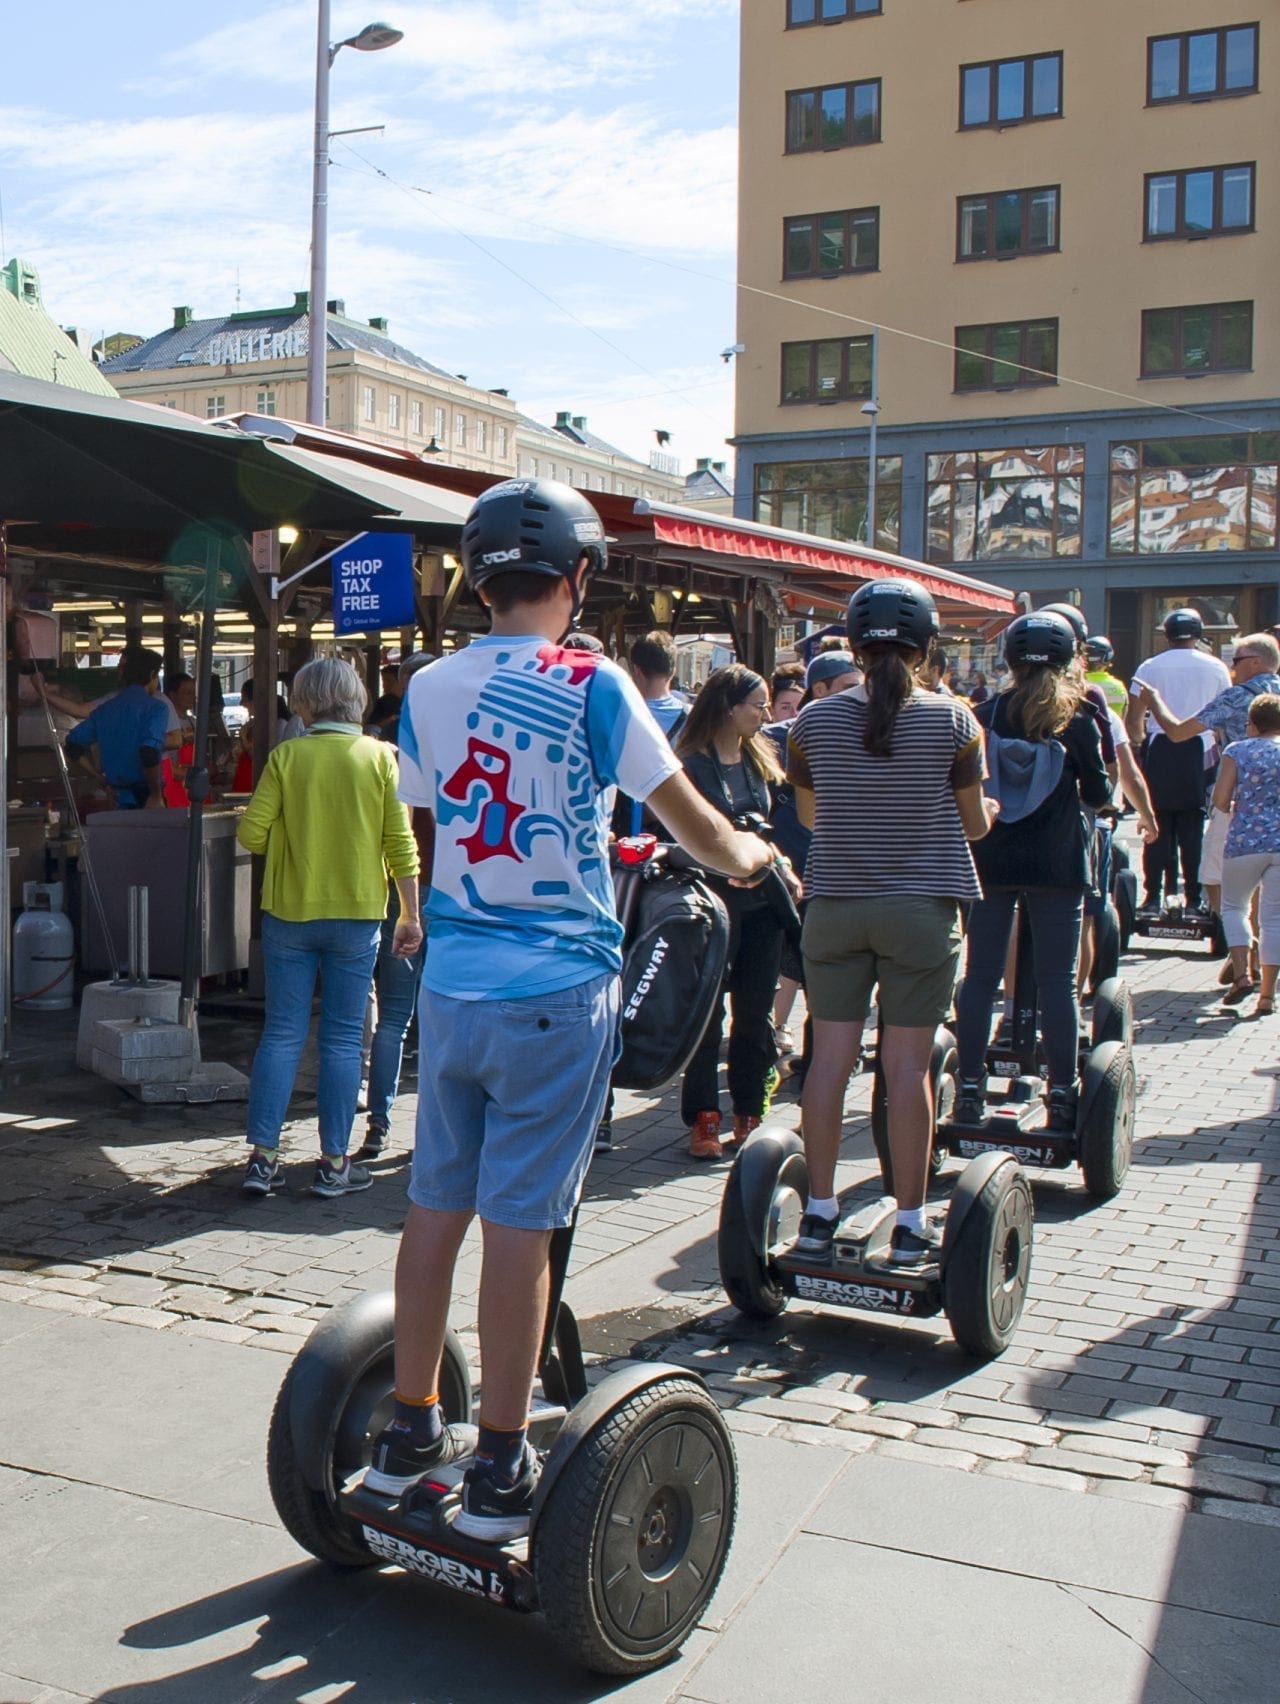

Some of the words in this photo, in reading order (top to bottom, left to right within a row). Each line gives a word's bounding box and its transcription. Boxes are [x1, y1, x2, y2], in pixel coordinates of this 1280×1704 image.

[209, 330, 308, 367] GALLERIE
[341, 559, 382, 576] SHOP
[341, 577, 371, 593] TAX
[342, 595, 380, 611] FREE
[624, 936, 669, 1020] SEGWAY
[959, 1139, 1042, 1158] BERGEN
[795, 1274, 898, 1302] BERGEN
[362, 1524, 483, 1587] BERGEN
